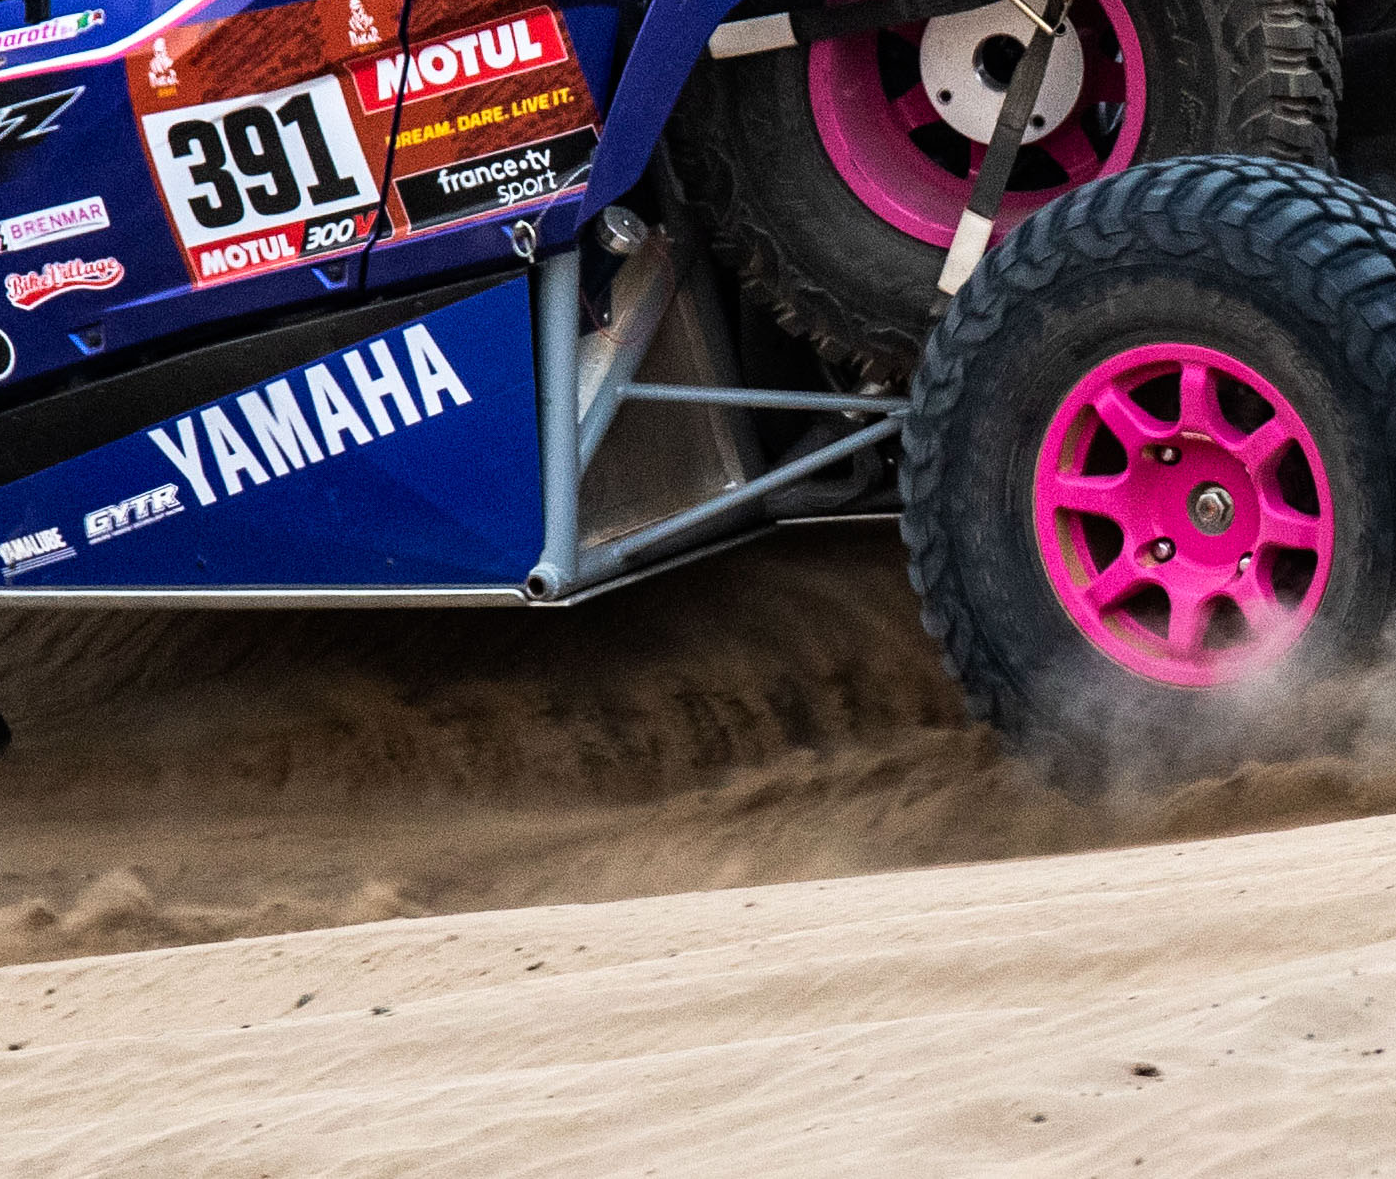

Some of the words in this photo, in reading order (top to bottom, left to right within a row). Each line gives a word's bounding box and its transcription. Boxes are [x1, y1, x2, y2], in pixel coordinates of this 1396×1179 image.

[376, 19, 543, 102] MOTUL
[457, 106, 510, 132] DARE.
[511, 93, 550, 118] LIVE
[552, 87, 575, 107] IT.
[167, 92, 361, 229] 391
[497, 171, 558, 207] sport
[10, 203, 103, 240] BRENMAR
[199, 233, 296, 277] MOTUL
[306, 209, 380, 251] 300V
[147, 323, 473, 506] YAMAHA
[83, 482, 181, 539] GYTR
